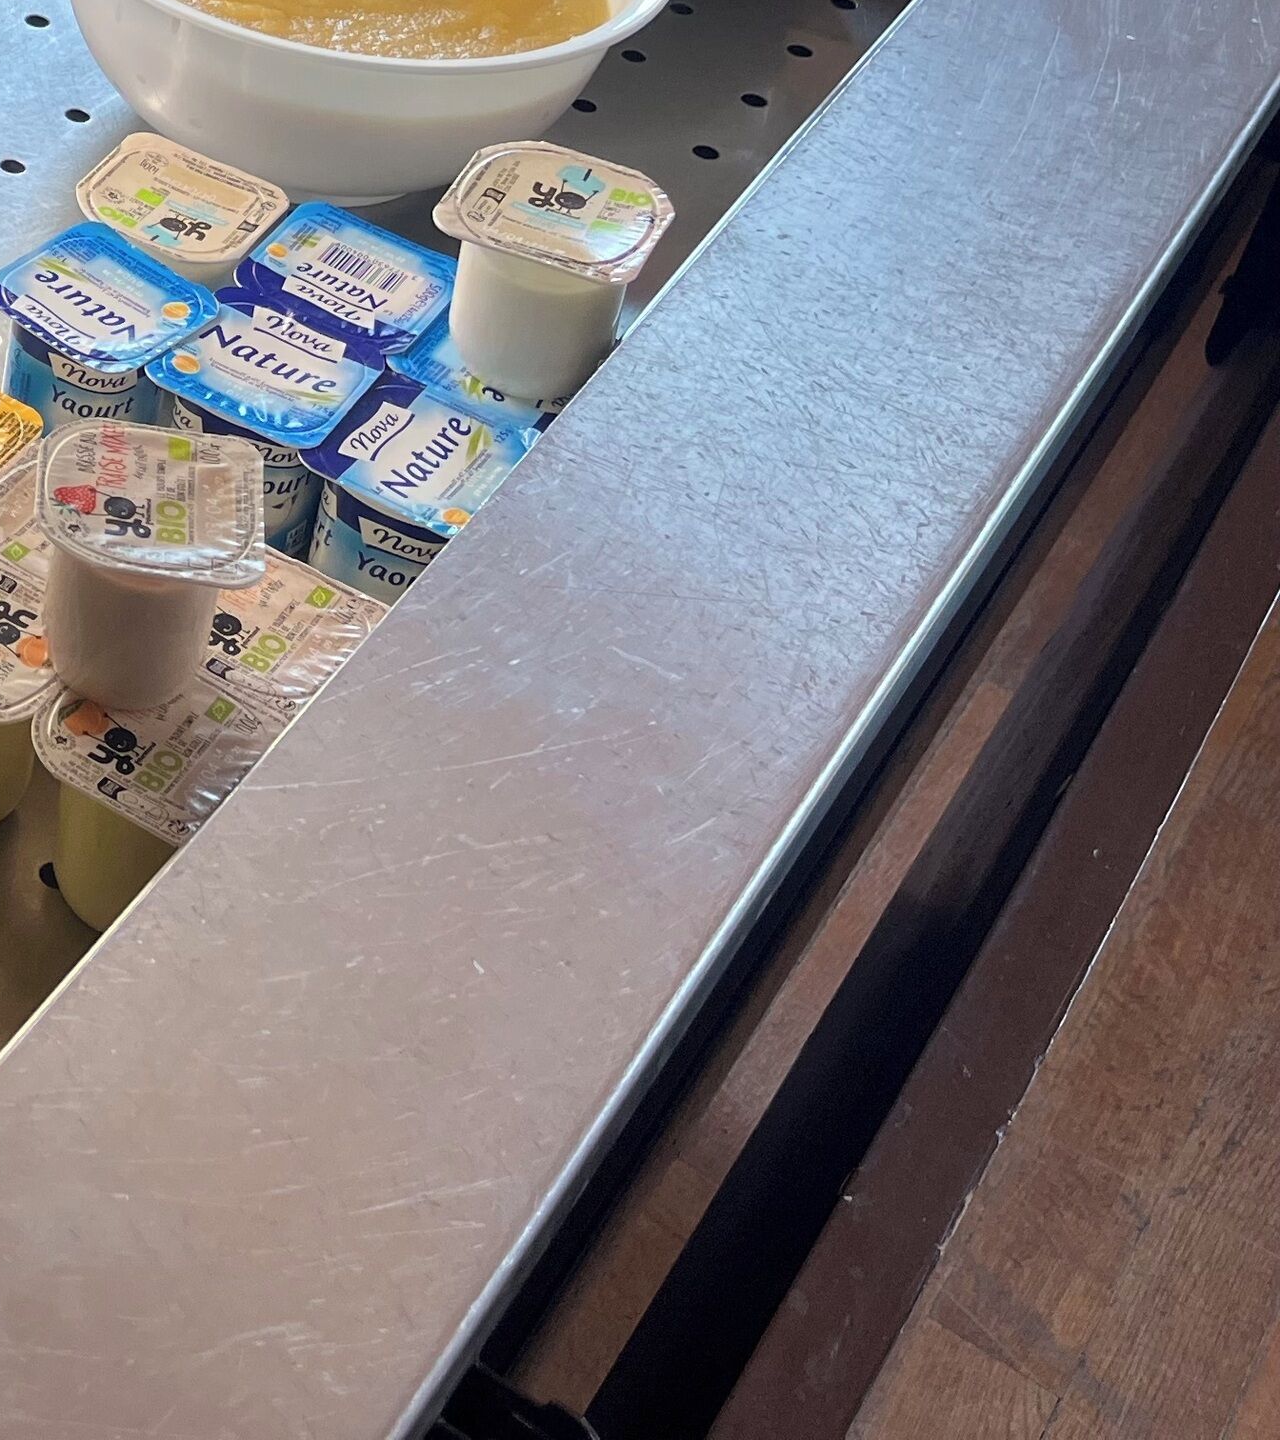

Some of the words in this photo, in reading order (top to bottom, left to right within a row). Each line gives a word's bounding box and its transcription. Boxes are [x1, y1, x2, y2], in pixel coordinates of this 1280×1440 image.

[296, 261, 389, 310] Nature
[296, 283, 361, 322] Nova
[25, 303, 82, 346] Nova
[266, 314, 334, 354] Nova
[61, 362, 127, 389] Nova
[199, 324, 337, 394] Nature
[52, 384, 135, 418] Yaourt
[251, 442, 298, 462] Nov
[350, 412, 400, 451] Nova
[379, 416, 472, 499] Nature
[155, 499, 188, 546] BIO
[240, 632, 289, 674] BIO
[134, 749, 184, 792] BIO
